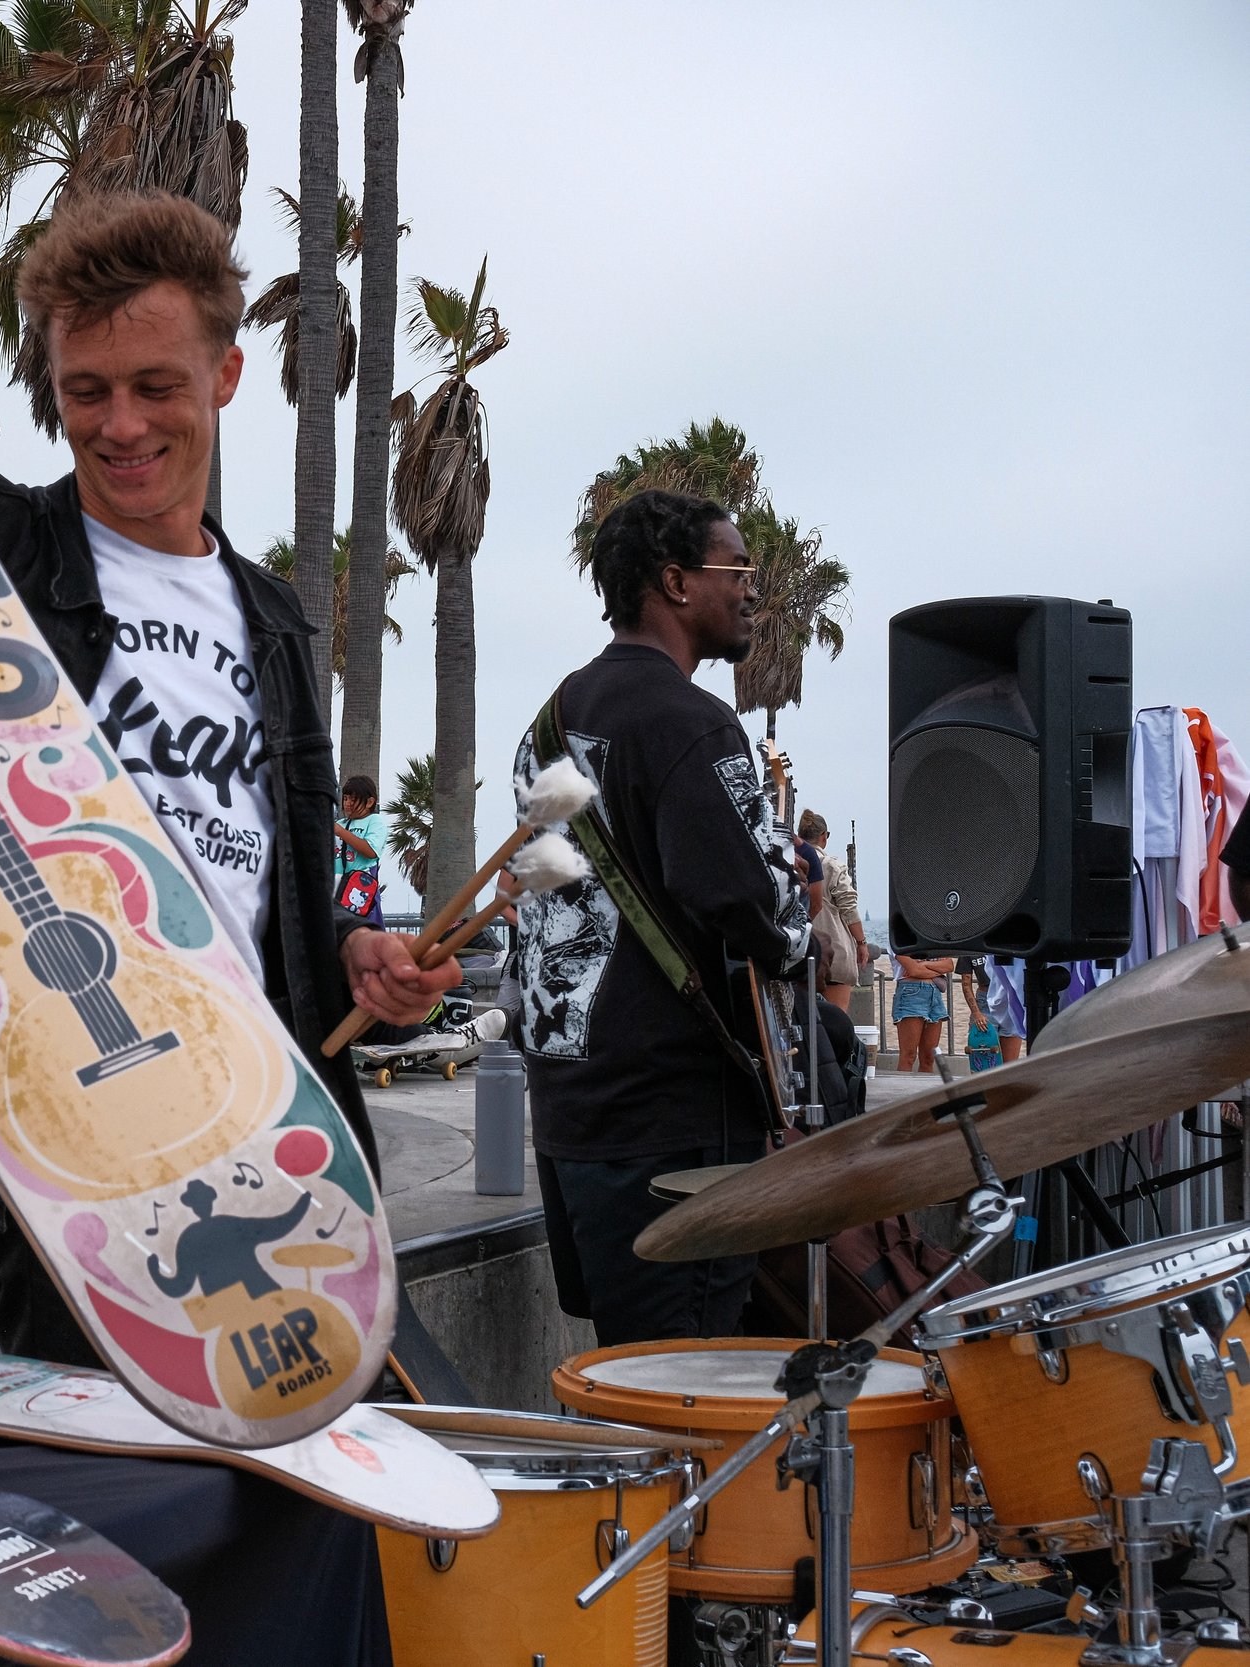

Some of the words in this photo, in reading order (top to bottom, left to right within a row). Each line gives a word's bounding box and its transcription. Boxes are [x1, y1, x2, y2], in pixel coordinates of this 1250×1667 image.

[115, 619, 199, 659] ORN
[213, 640, 255, 697] TO
[156, 793, 203, 833] EST
[206, 817, 262, 851] COAST
[194, 837, 262, 875] SUPPLY
[229, 1307, 324, 1391] LEAP
[276, 1360, 332, 1398] BOARDS
